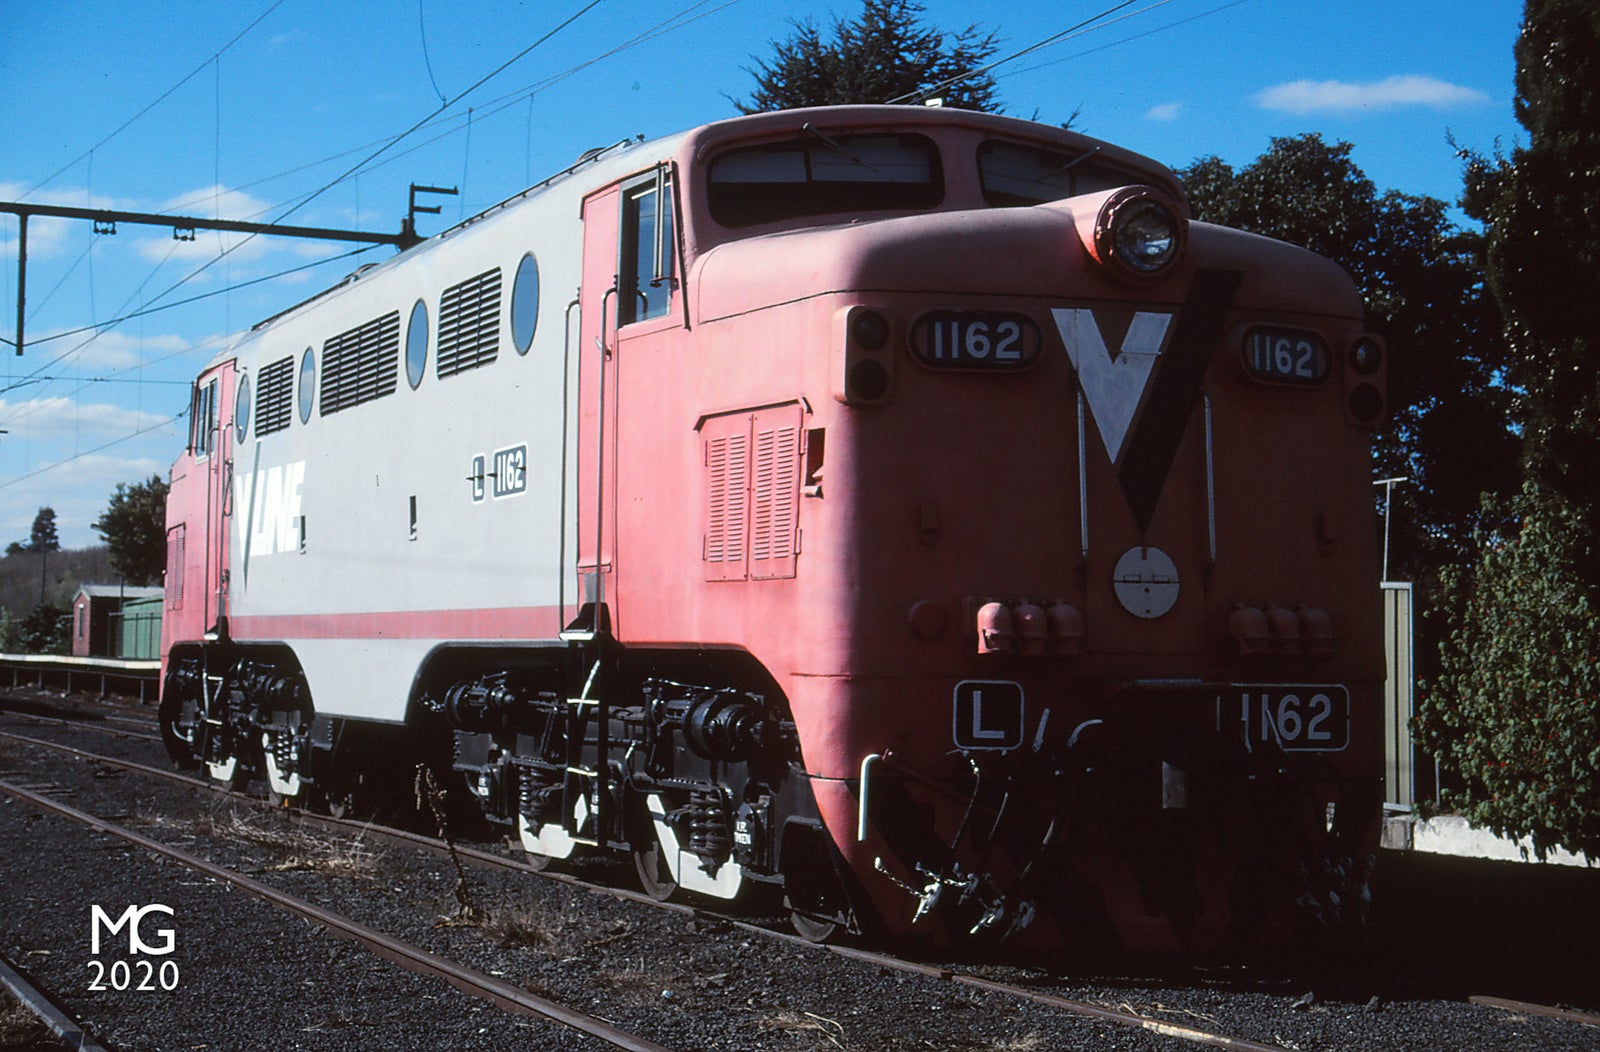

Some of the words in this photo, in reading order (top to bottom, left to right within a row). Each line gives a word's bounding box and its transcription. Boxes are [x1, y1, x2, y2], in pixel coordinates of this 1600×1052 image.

[934, 320, 1022, 360] 1162
[1253, 333, 1314, 378] 1162
[1051, 308, 1172, 464] V
[474, 461, 483, 497] L
[497, 450, 523, 492] 1162
[972, 690, 1005, 739] L
[1242, 693, 1331, 740] 1162
